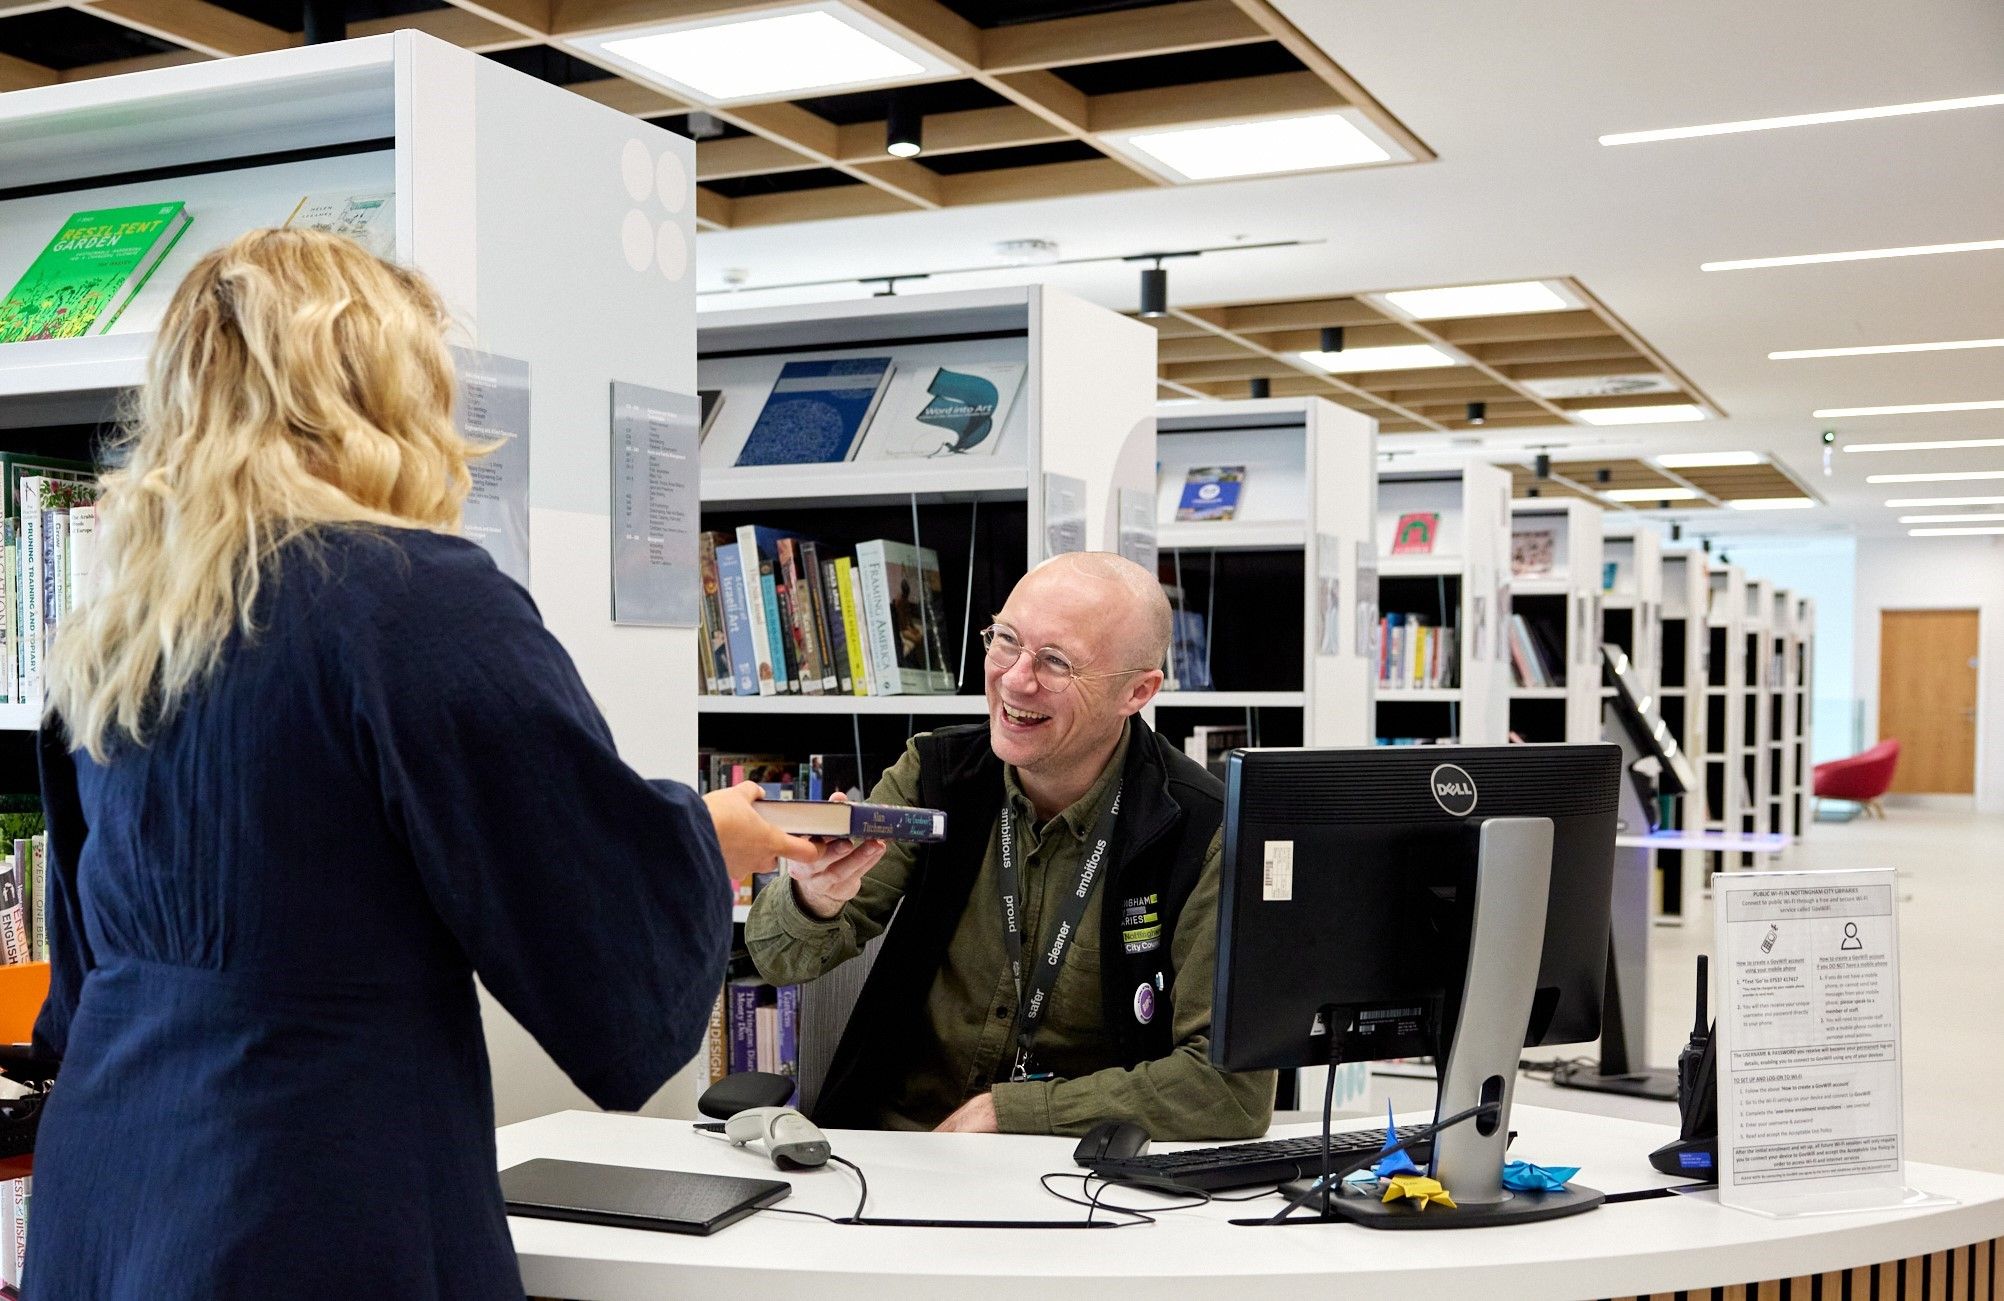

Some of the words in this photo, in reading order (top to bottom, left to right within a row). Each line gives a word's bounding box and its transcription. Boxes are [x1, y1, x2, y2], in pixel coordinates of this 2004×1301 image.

[53, 235, 122, 252] GARDEN
[61, 220, 163, 240] RESILIENT
[925, 406, 952, 415] Word
[953, 405, 974, 414] into
[975, 404, 992, 412] Art
[869, 562, 882, 622] FRAMING
[878, 620, 892, 670] AMERICA
[1436, 782, 1473, 796] DELL
[1001, 807, 1012, 868] ambitious
[1076, 839, 1107, 898] ambitious
[1003, 895, 1018, 932] proud
[1047, 920, 1071, 966] cleaner
[1126, 943, 1140, 953] City
[737, 992, 745, 1021] Monty
[746, 991, 755, 1008] The
[1028, 988, 1045, 1019] safer
[737, 1022, 745, 1041] Don
[711, 1028, 721, 1077] DESIGN
[15, 1218, 24, 1268] DISEASES
